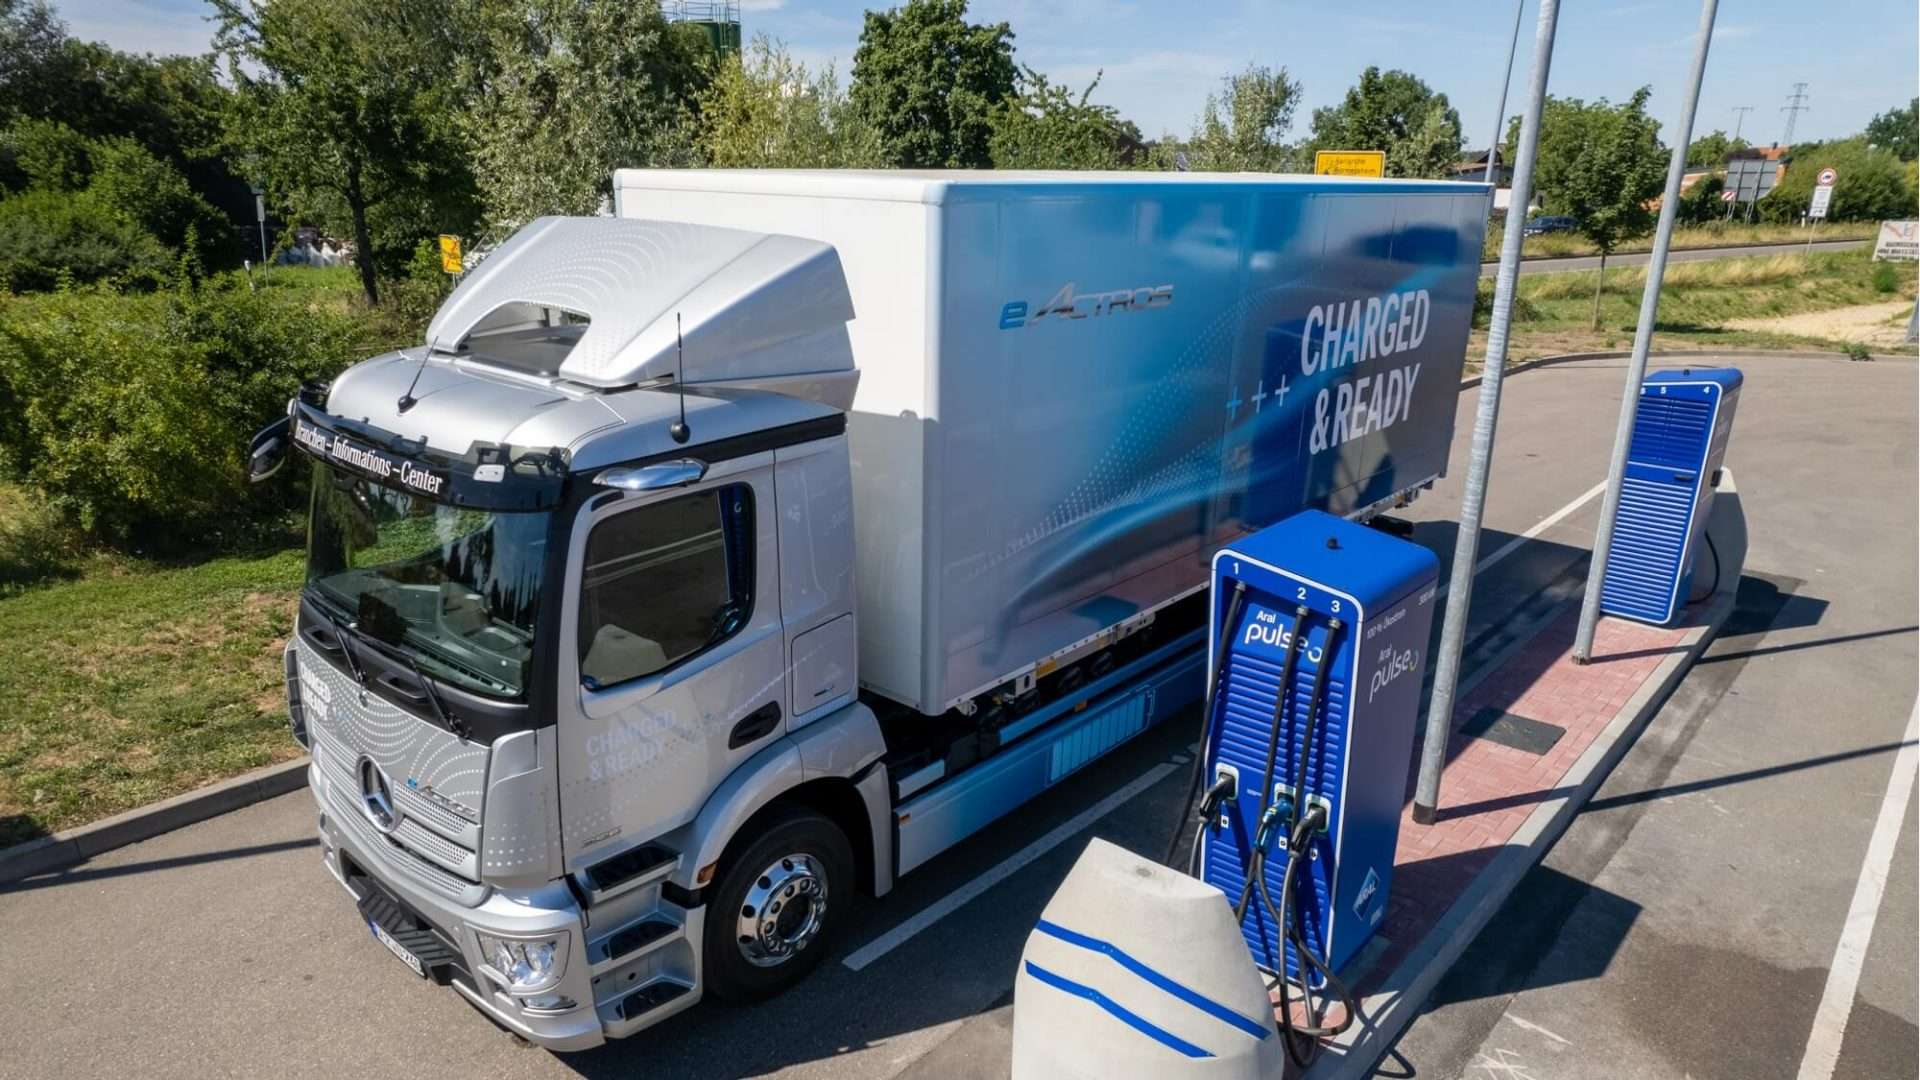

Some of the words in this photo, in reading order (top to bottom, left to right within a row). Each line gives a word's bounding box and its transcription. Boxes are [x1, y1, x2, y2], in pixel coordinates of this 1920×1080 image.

[1301, 289, 1430, 376] CHARGED
[1309, 388, 1330, 455] &
[1331, 362, 1421, 448] READY
[1703, 386, 1710, 394] 4
[1232, 562, 1240, 575] 1
[1297, 587, 1307, 600] 2
[1331, 600, 1341, 613] 3
[1256, 610, 1277, 624] Aral
[1369, 649, 1411, 704] pulse
